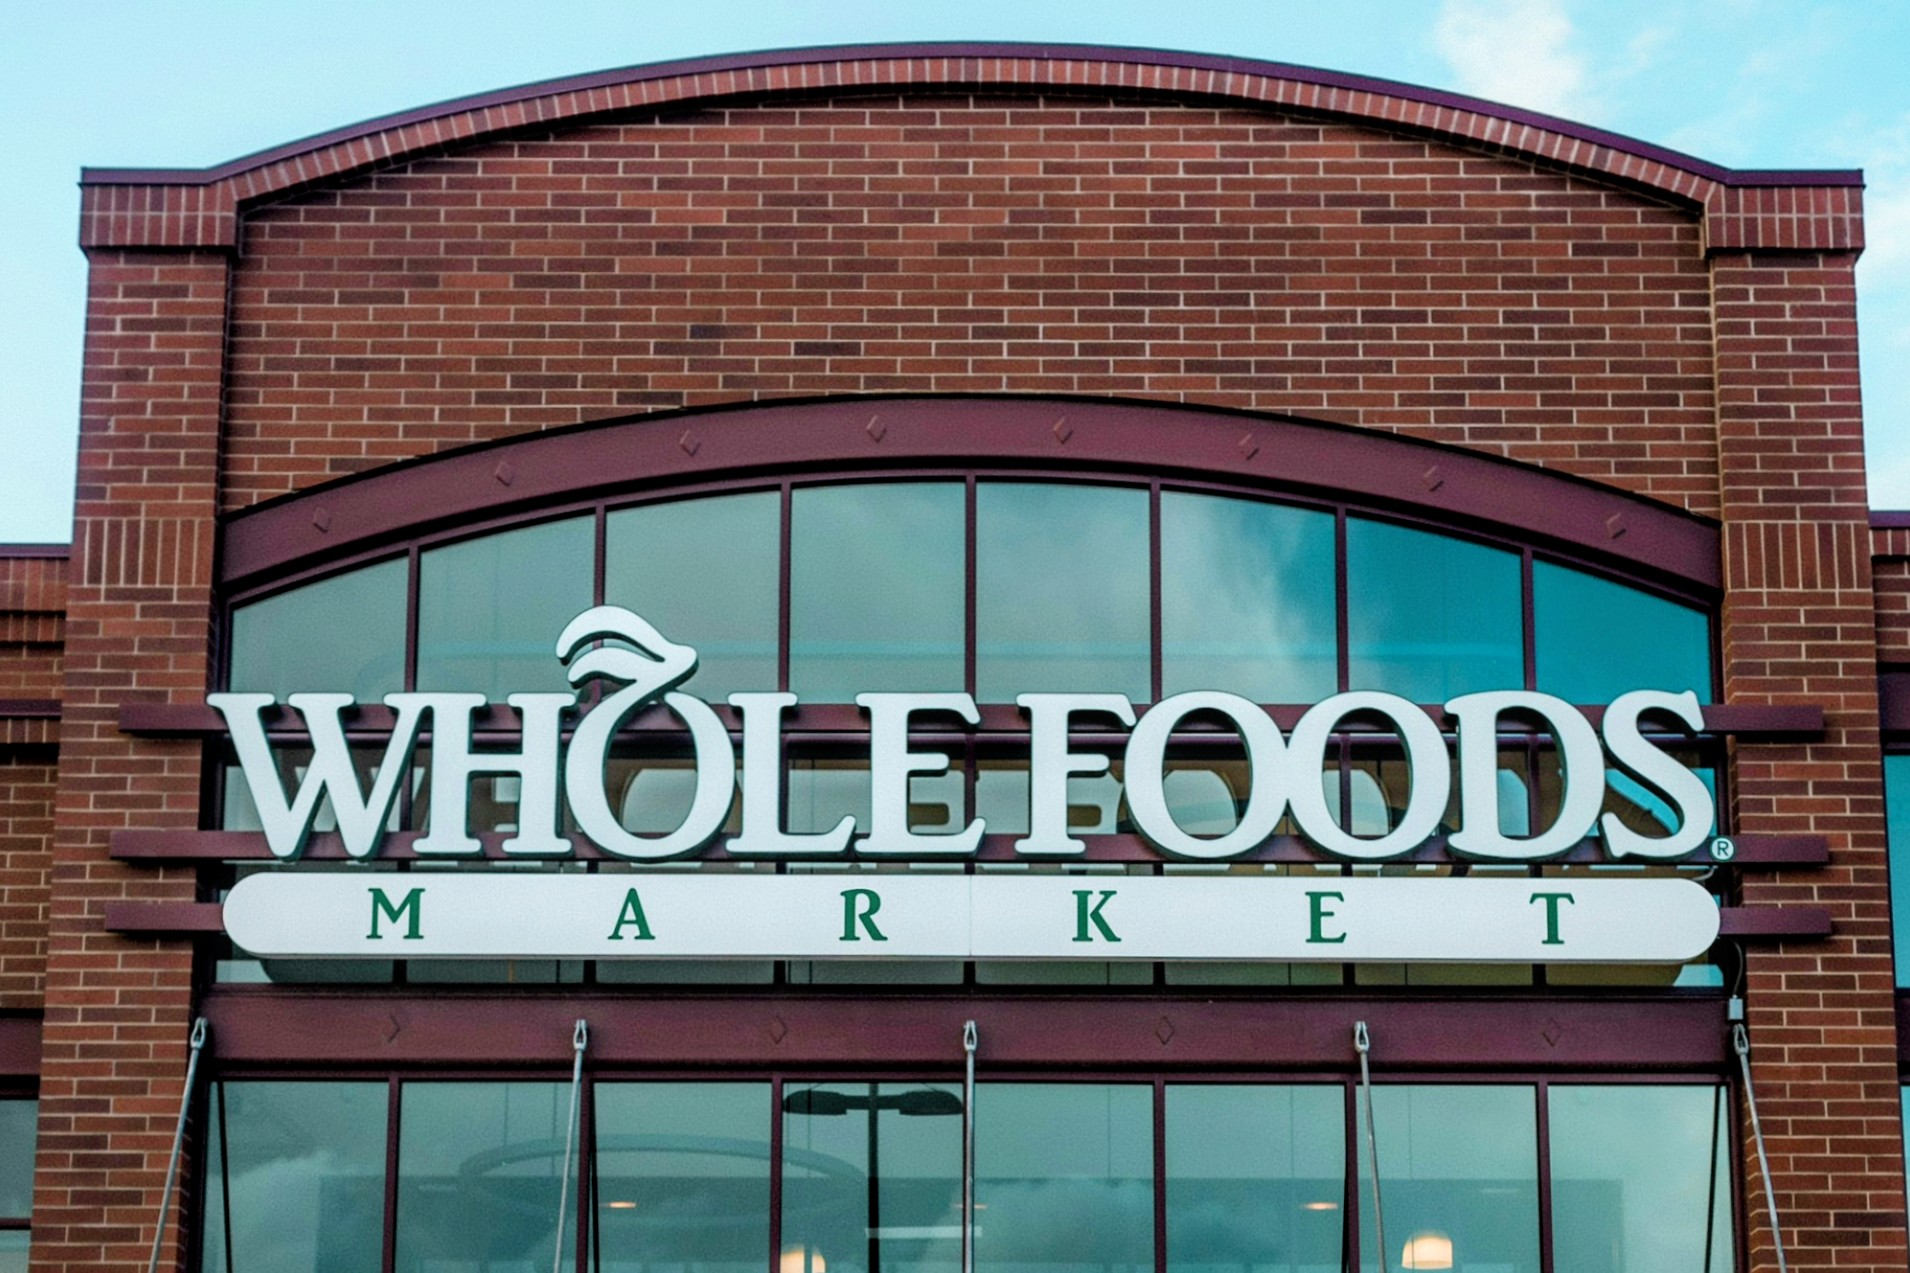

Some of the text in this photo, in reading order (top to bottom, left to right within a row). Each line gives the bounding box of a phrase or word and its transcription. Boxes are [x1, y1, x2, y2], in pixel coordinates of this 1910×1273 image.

[206, 605, 987, 859] WHOLE
[1014, 690, 1715, 859] FOODS
[366, 887, 1575, 944] MARKET
